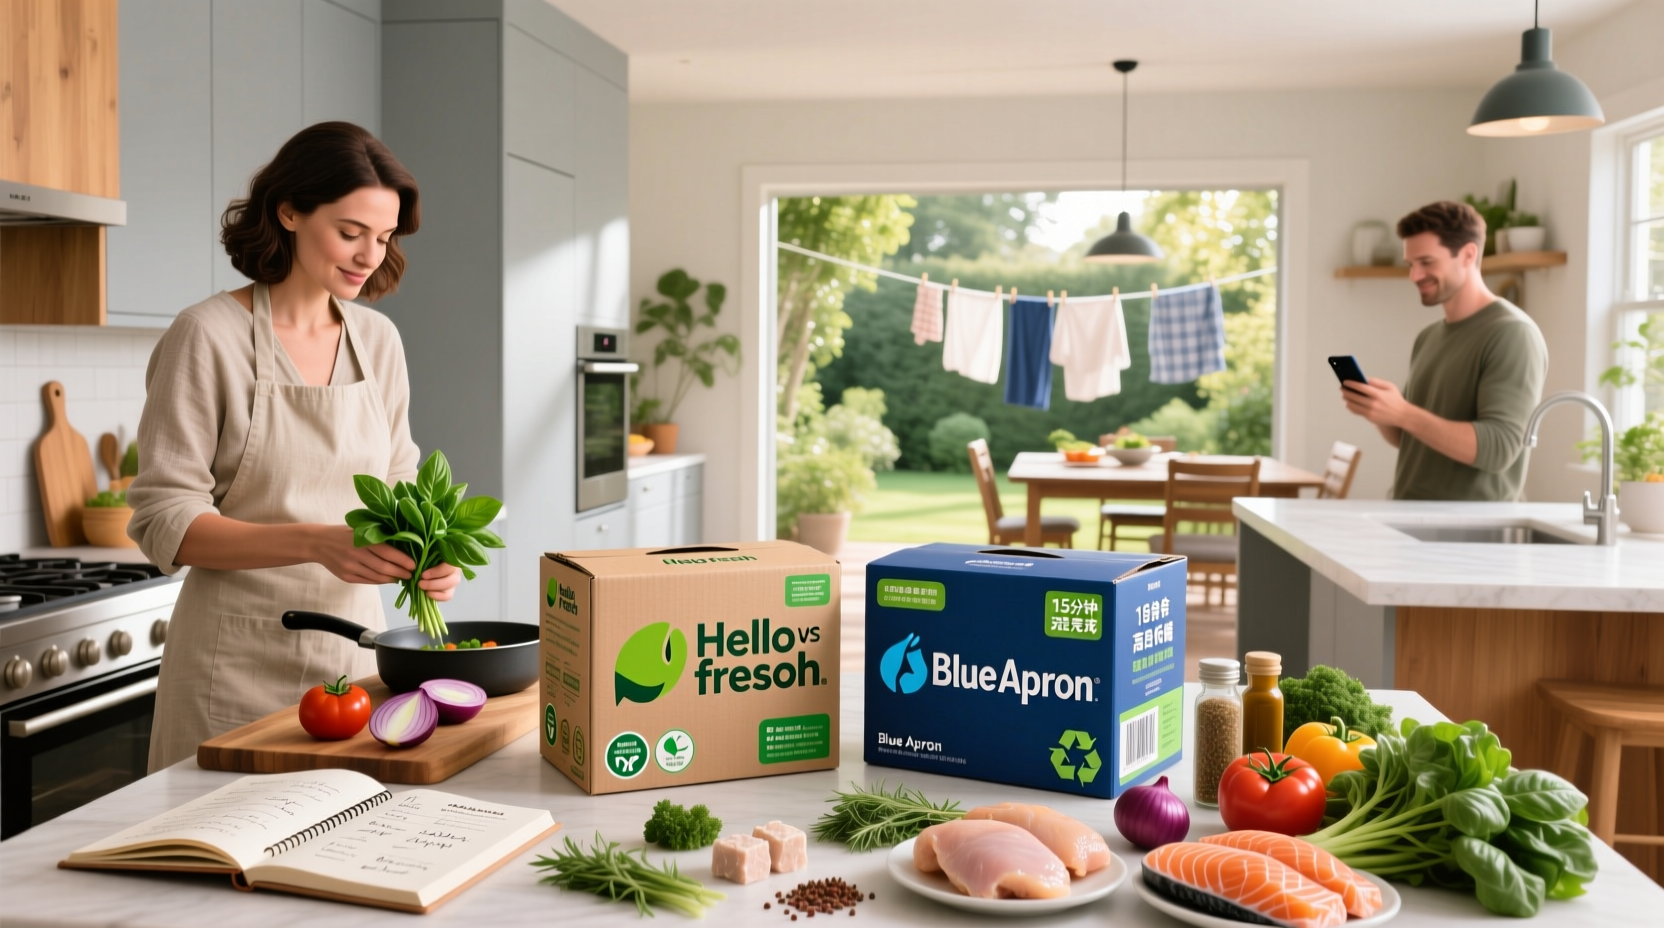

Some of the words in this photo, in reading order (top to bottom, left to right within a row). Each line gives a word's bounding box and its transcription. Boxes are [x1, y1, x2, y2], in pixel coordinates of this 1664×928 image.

[697, 618, 796, 658] Hello
[694, 651, 821, 695] fresoh
[878, 732, 903, 747] Blue
[905, 735, 942, 752] Apron
